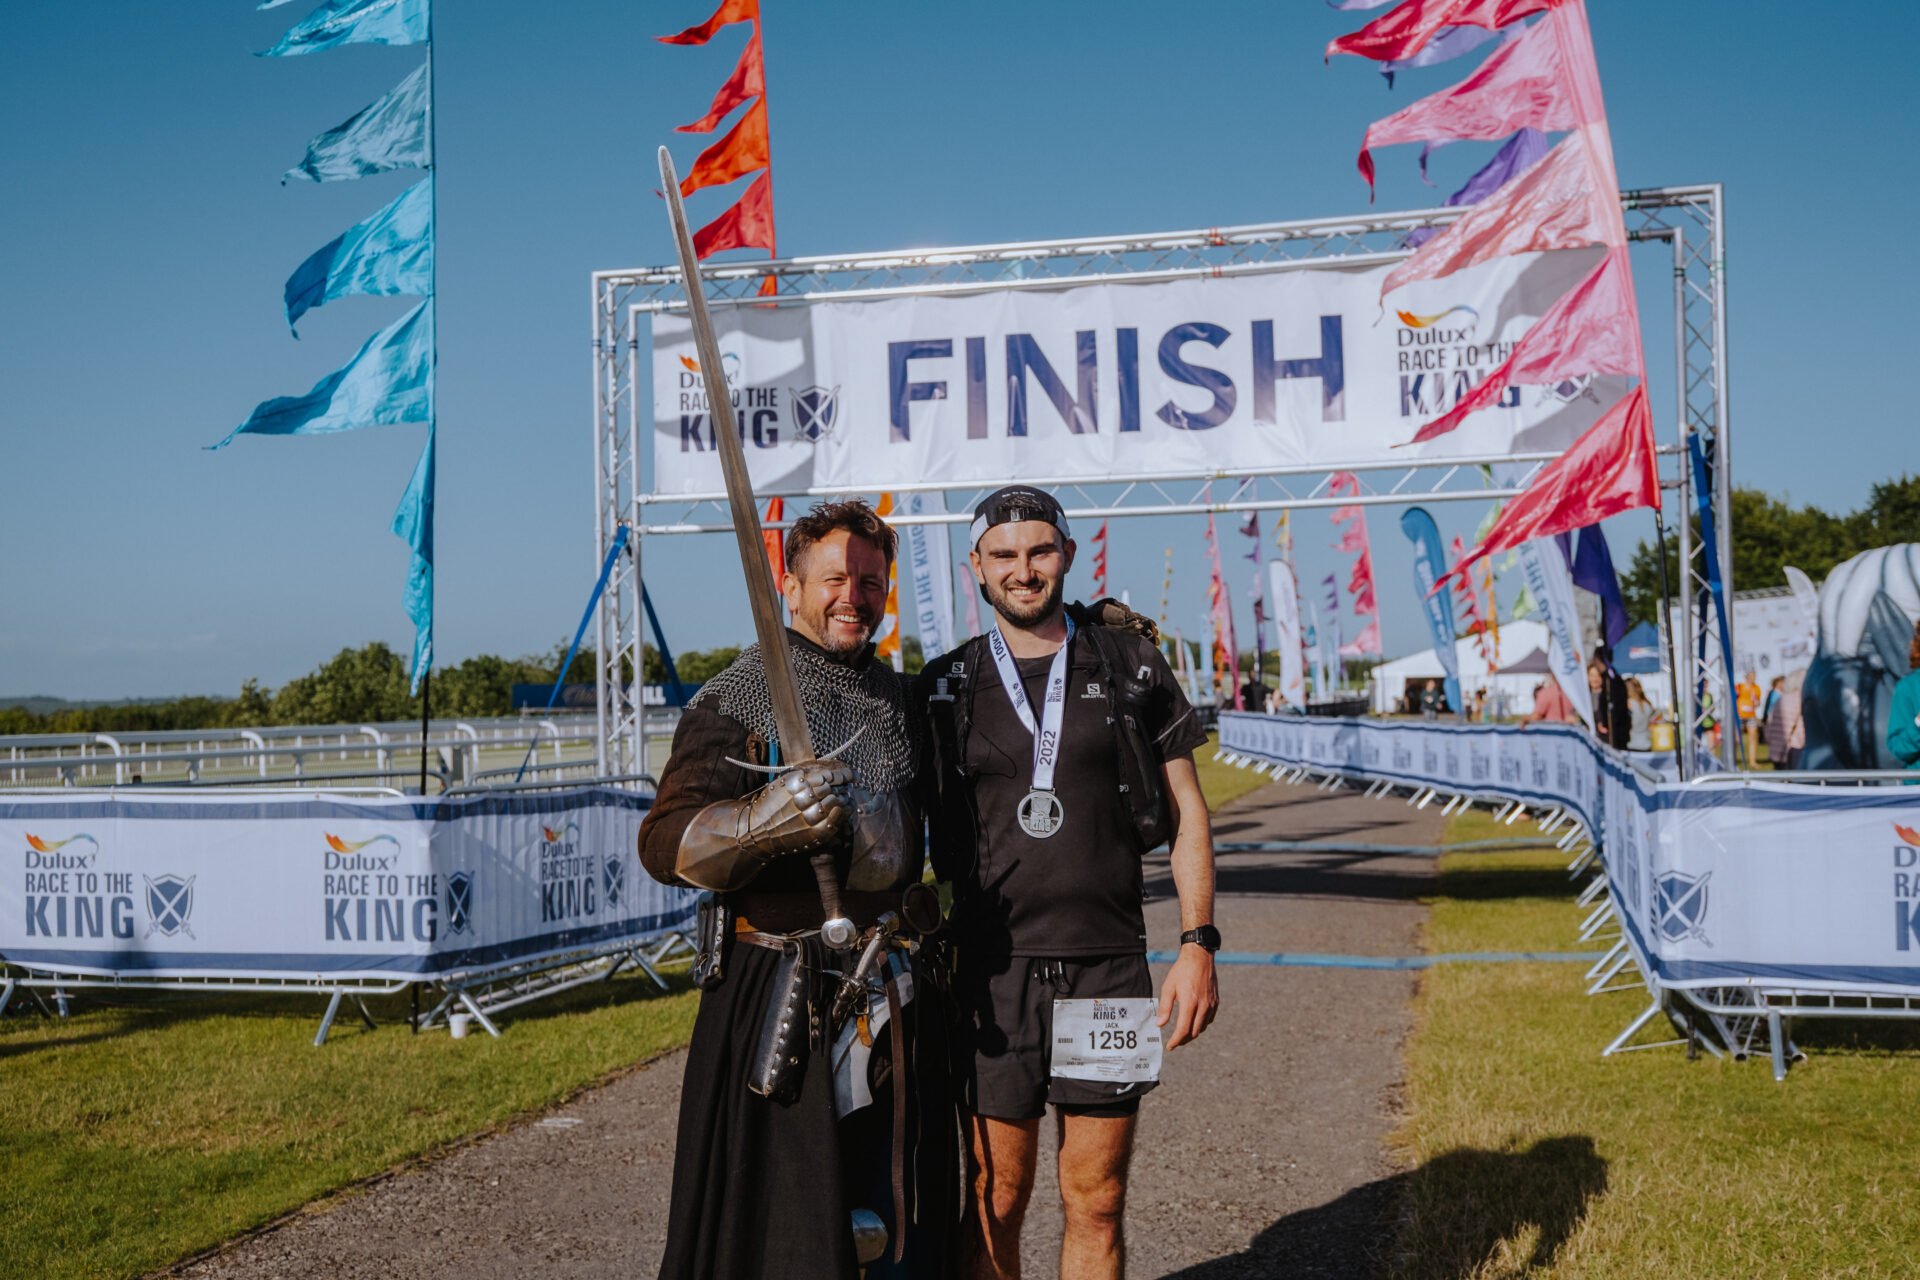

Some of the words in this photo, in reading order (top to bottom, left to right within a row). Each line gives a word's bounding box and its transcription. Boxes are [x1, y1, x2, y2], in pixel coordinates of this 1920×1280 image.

[1397, 327, 1467, 347] Dulux
[1399, 348, 1447, 371] RACE
[1454, 345, 1478, 366] TO
[1486, 342, 1520, 364] TH
[887, 314, 1346, 444] FINISH
[746, 387, 778, 408] THE
[1039, 730, 1056, 766] 2022
[25, 851, 88, 869] Dulux
[542, 841, 575, 858] Dulux
[324, 852, 389, 871] Dulux
[542, 860, 567, 881] RACE
[567, 857, 580, 877] TO
[25, 872, 69, 893] RACE
[75, 872, 98, 893] TO
[104, 872, 133, 894] THE
[324, 874, 369, 895] RACE
[376, 875, 399, 896] TO
[405, 874, 438, 896] THE
[542, 876, 596, 923] KING
[25, 895, 135, 939] KING
[325, 898, 438, 942] KING
[1093, 1011, 1116, 1020] KING
[1088, 1030, 1137, 1050] 1258
